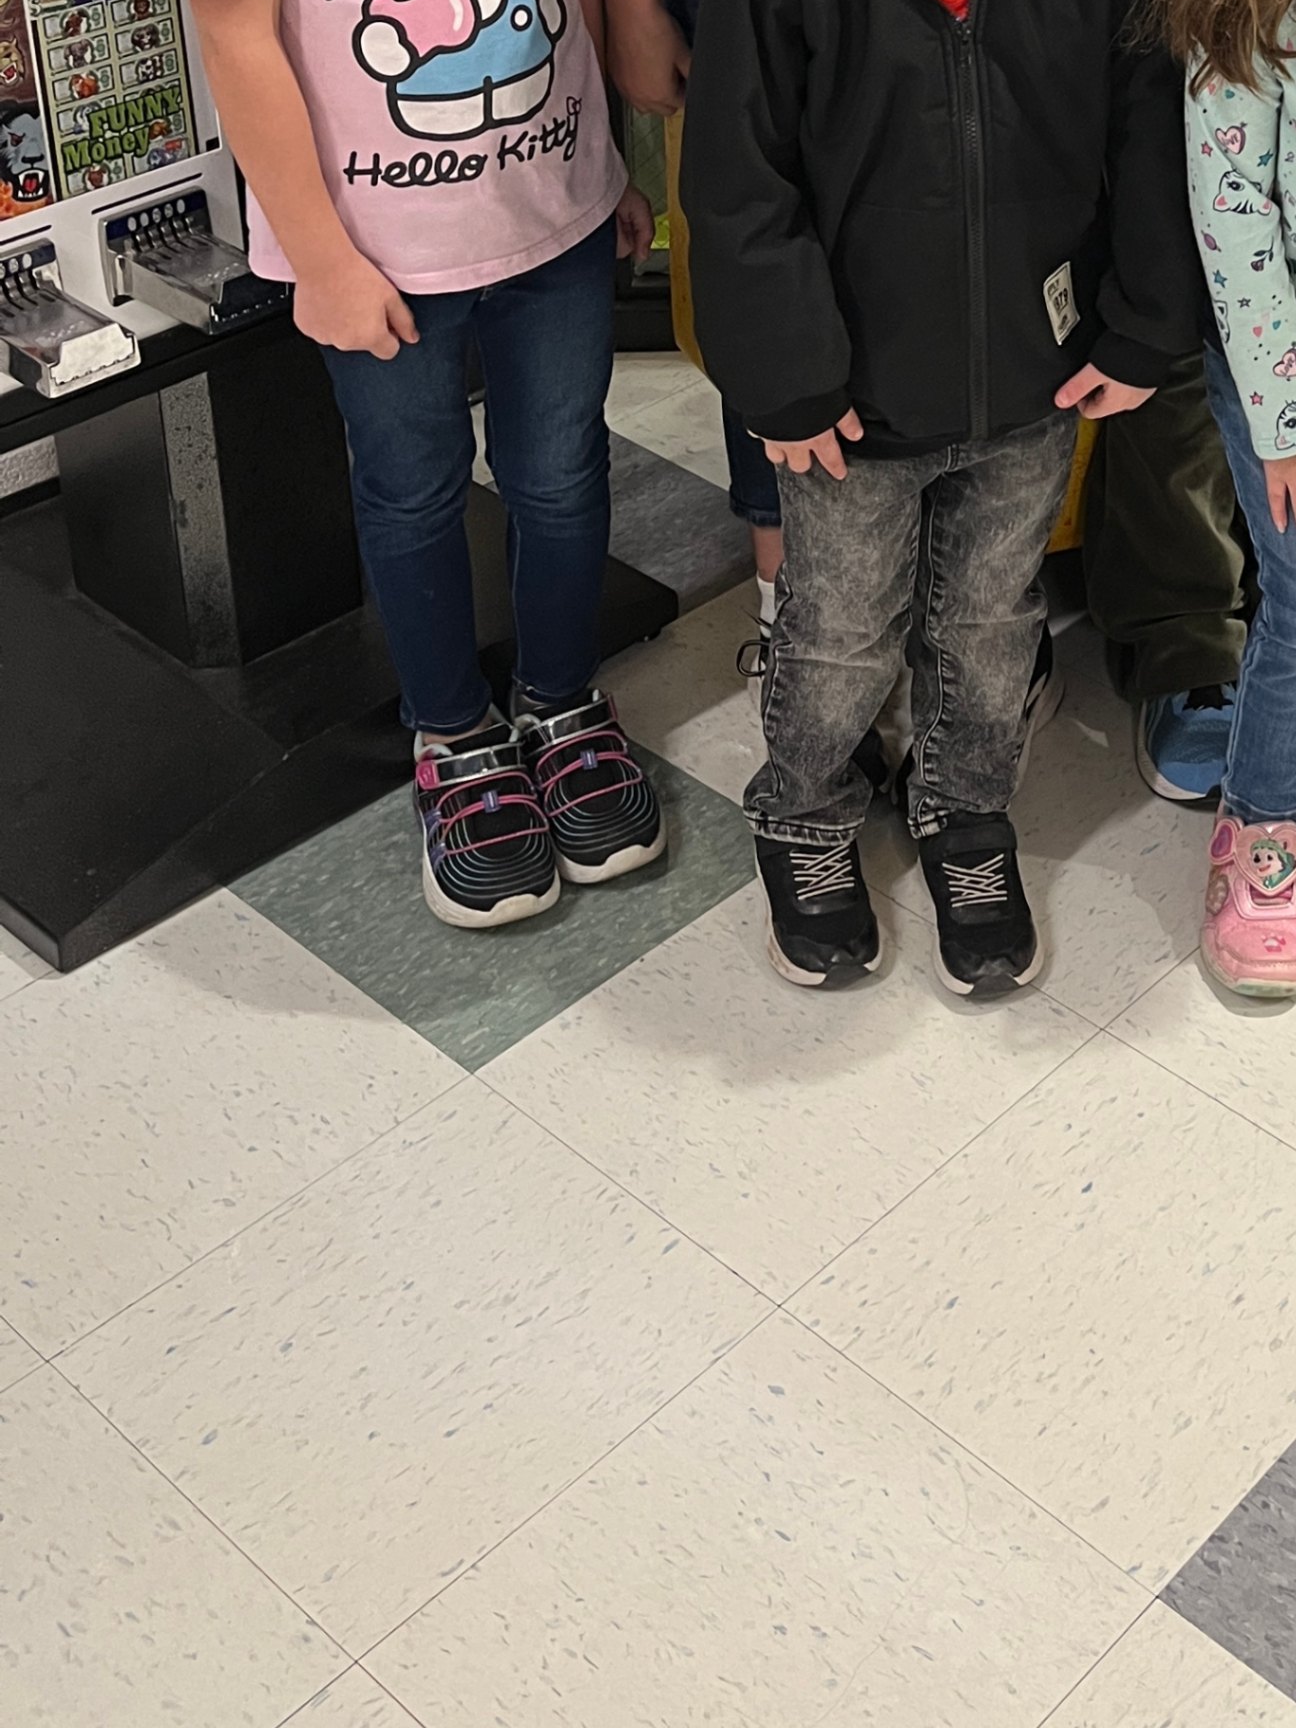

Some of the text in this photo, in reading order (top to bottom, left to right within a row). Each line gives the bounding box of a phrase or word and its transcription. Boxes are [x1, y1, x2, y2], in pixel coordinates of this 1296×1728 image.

[87, 86, 181, 139] FUNNY
[62, 125, 150, 171] Money
[343, 105, 581, 188] Hello Kitty
